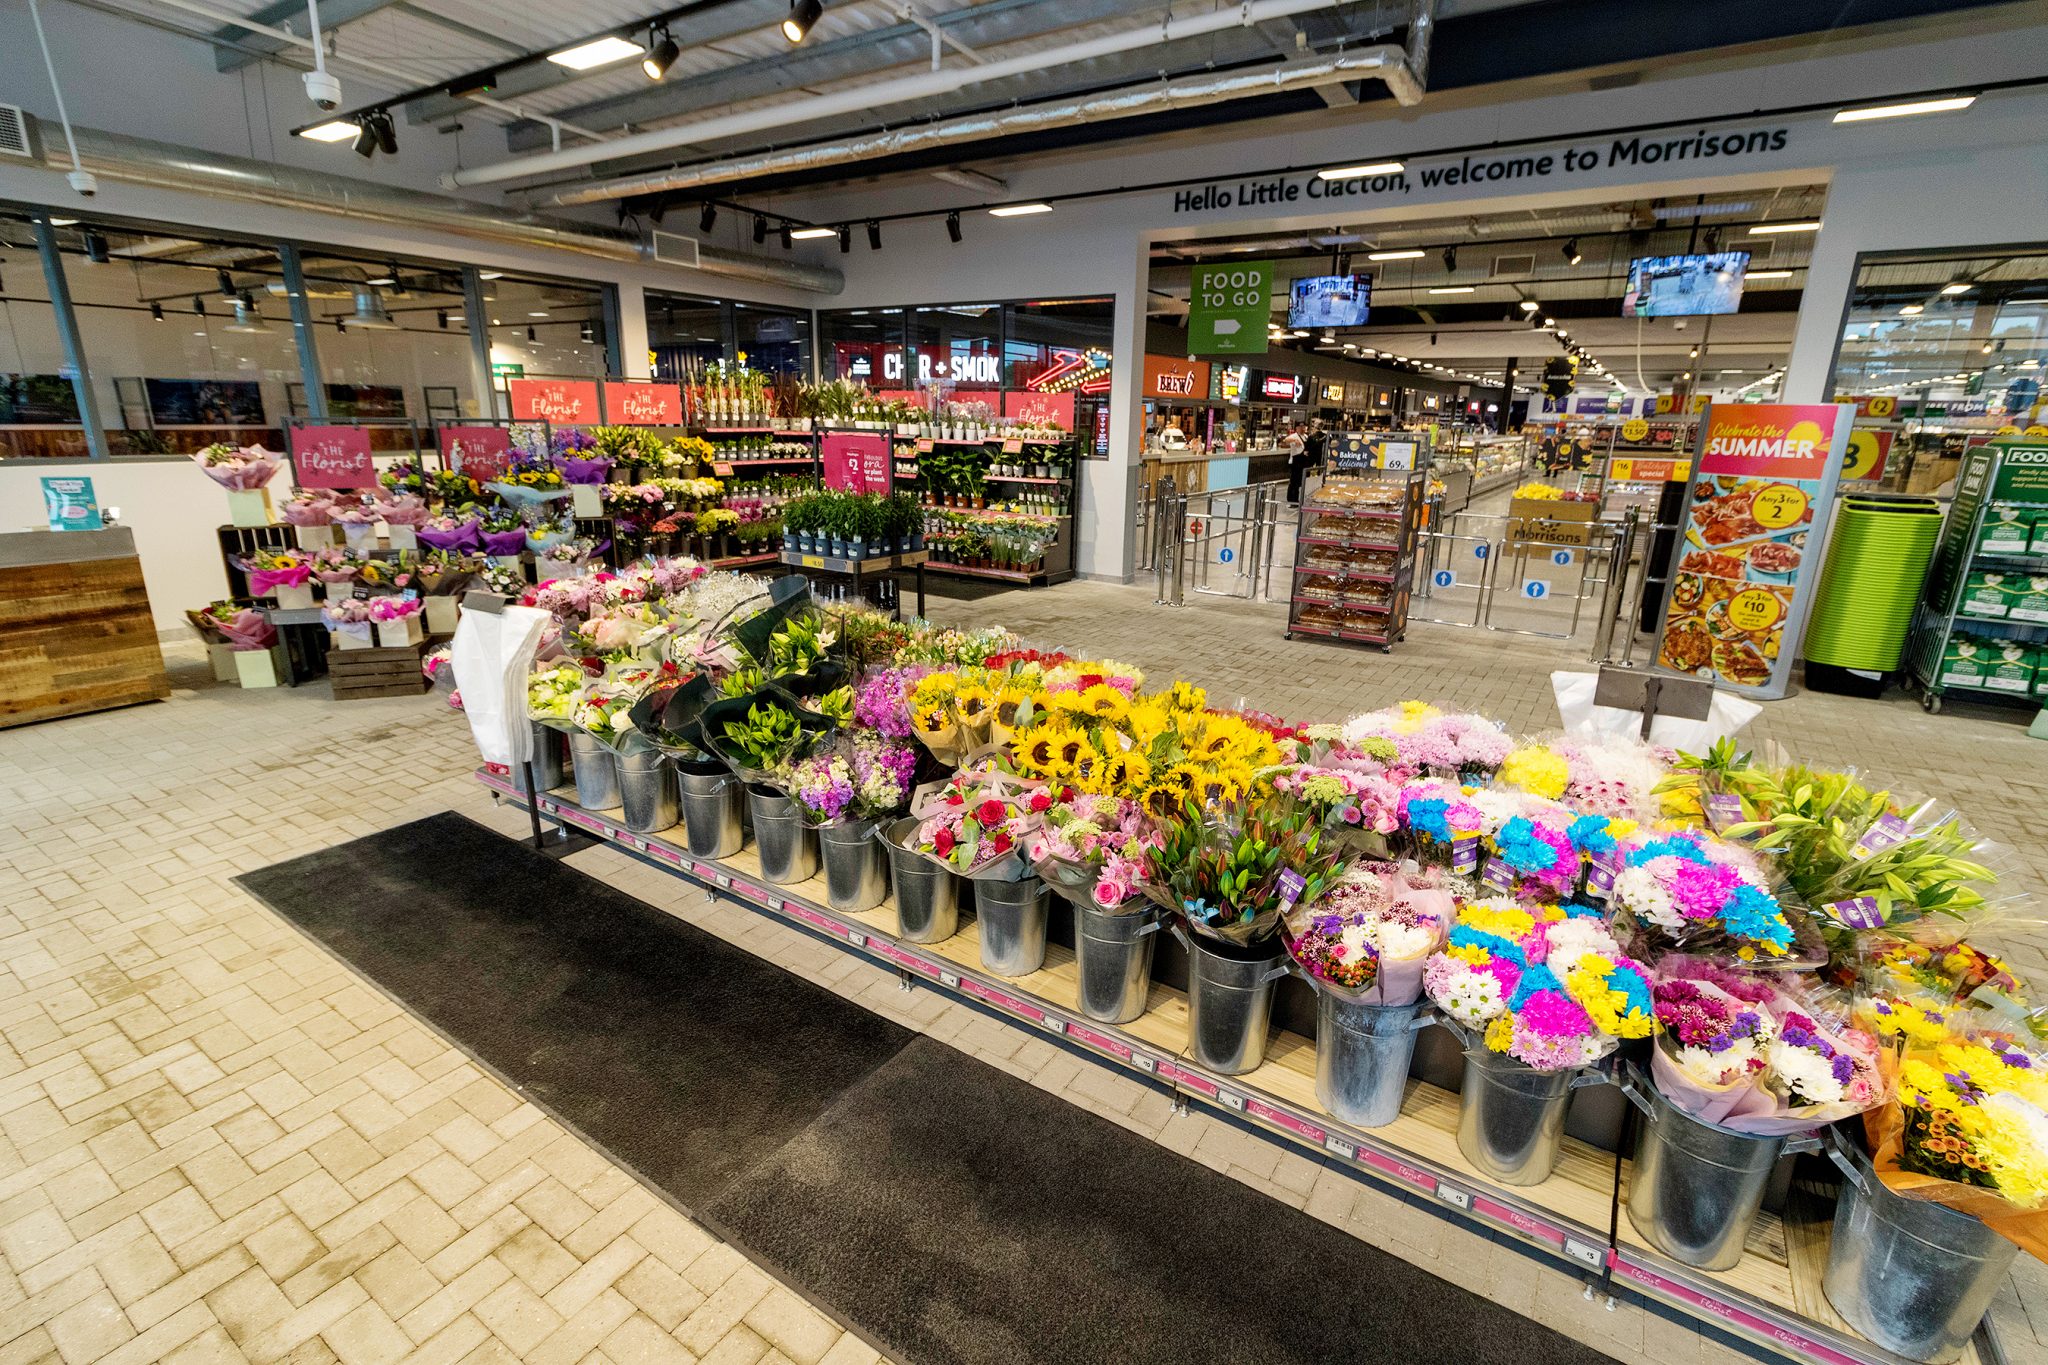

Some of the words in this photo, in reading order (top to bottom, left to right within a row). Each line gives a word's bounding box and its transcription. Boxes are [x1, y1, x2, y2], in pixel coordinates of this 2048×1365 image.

[1174, 187, 1232, 212] Hello
[1238, 178, 1299, 206] Little
[1421, 147, 1553, 188] welcome
[1564, 149, 1599, 172] to
[1608, 129, 1788, 168] Morrisons
[1202, 271, 1262, 290] FOOD
[1201, 293, 1225, 308] TO
[1233, 291, 1260, 306] GO
[950, 355, 1000, 382] SMOK
[531, 398, 582, 416] Florist
[623, 399, 667, 416] Florist
[1033, 403, 1046, 412] THE
[1873, 400, 1888, 413] £2
[1951, 403, 1984, 412] FROM
[1019, 408, 1060, 425] Florist
[1712, 422, 1761, 437] Celebrate
[1762, 424, 1784, 438] the
[322, 445, 343, 457] THE
[468, 444, 486, 453] THE
[1340, 451, 1361, 460] Baking
[1362, 451, 1368, 459] it
[1709, 437, 1814, 459] SUMMER
[301, 451, 368, 470] Florist
[849, 459, 859, 471] £2
[864, 461, 884, 469] ora
[1338, 459, 1368, 468] delicious
[1389, 460, 1404, 470] 69p
[2010, 452, 2048, 463] FOO
[1639, 470, 1665, 478] special
[1761, 495, 1778, 504] Any
[1779, 494, 1785, 503] 3
[1772, 506, 1782, 518] 2
[1514, 529, 1581, 544] Morrisons
[1744, 601, 1765, 613] £10
[1253, 1104, 1273, 1118] Florist
[1299, 1123, 1320, 1138] Florist
[1399, 1165, 1423, 1181] Florist
[1510, 1212, 1537, 1229] Florist
[1631, 1268, 1660, 1287] Florist
[1700, 1297, 1732, 1316] Florist
[1774, 1329, 1809, 1350] Florist
